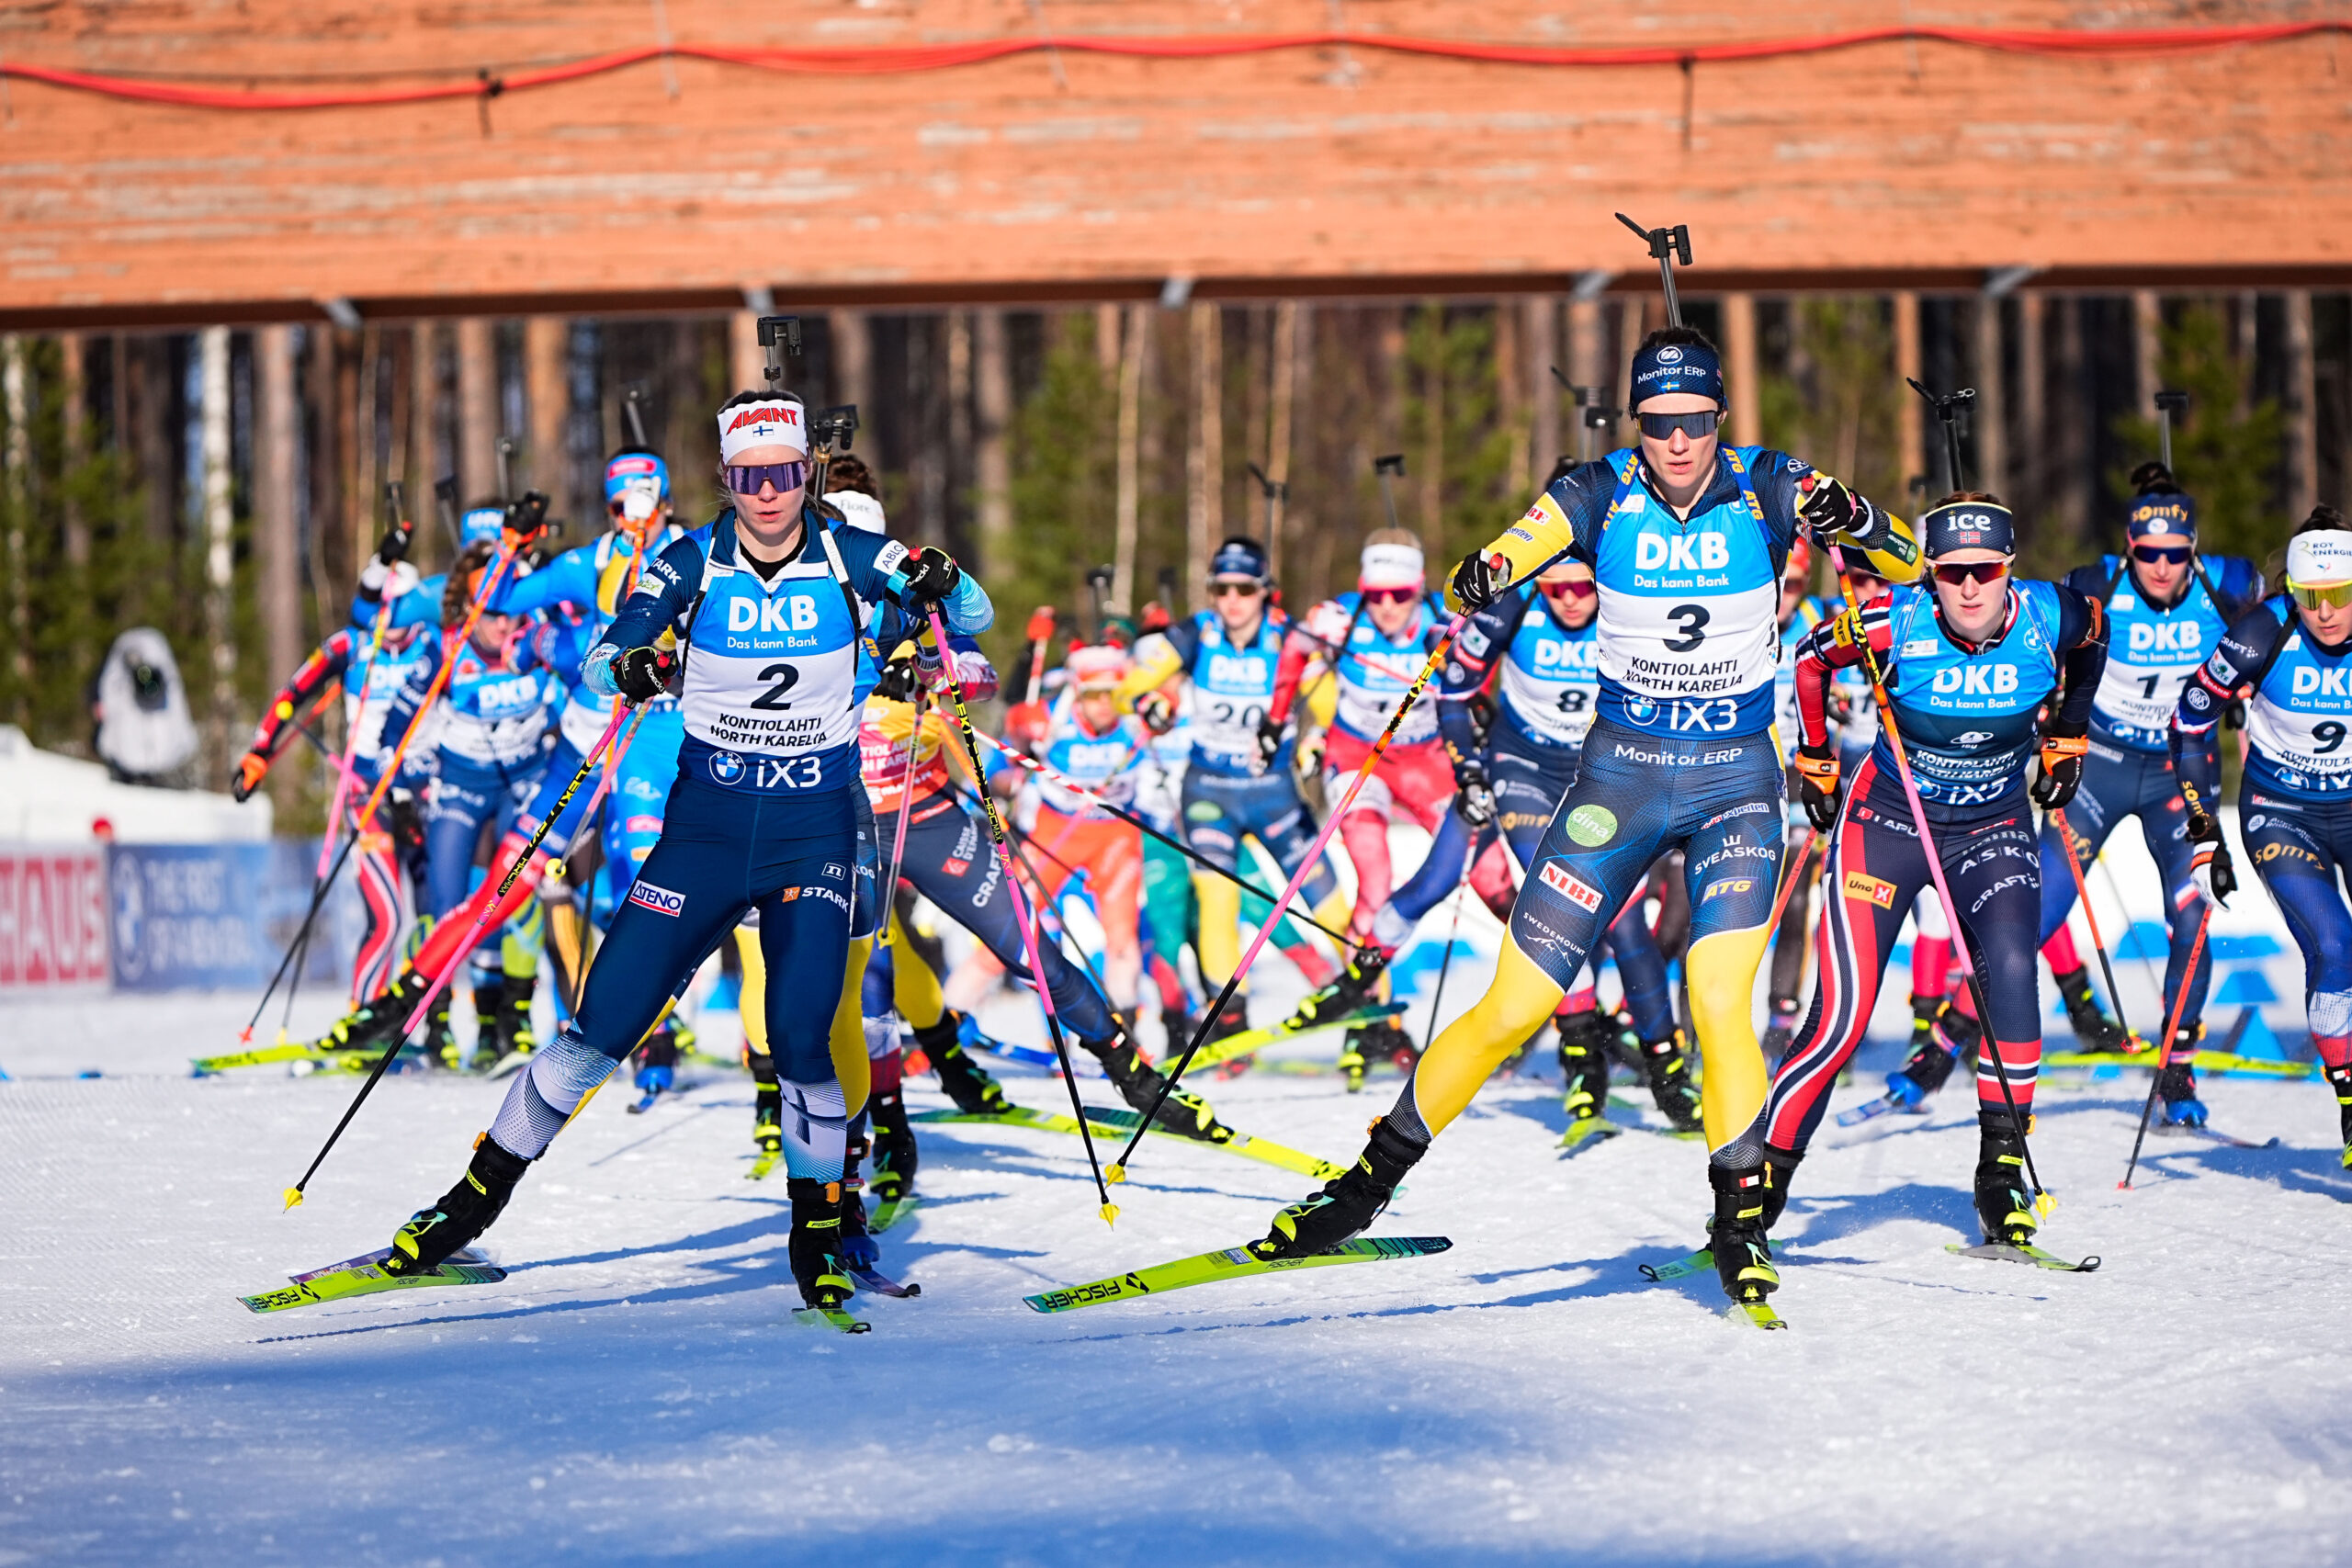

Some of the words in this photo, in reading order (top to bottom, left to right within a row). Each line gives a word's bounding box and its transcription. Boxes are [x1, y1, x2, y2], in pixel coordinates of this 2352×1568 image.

[1637, 367, 1682, 384] Monitor
[1684, 366, 1706, 378] ERP
[726, 407, 797, 435] AVANT
[1620, 454, 1639, 485] ATG
[1723, 447, 1745, 473] ATG
[1743, 490, 1764, 520] ATG
[2132, 503, 2188, 522] somfy
[1948, 510, 1991, 531] ice
[1635, 532, 1729, 570] DKB
[1634, 574, 1657, 588] Das
[1662, 576, 1692, 588] kann
[1696, 573, 1729, 587] Bank
[728, 595, 819, 632] DKB
[727, 637, 750, 649] Das
[753, 637, 784, 649] kann
[787, 635, 818, 648] Bank
[1663, 604, 1711, 653] 3
[2129, 620, 2202, 651] DKB
[645, 663, 665, 693] Roeckl
[1632, 656, 1738, 676] KONTIOLAHTI
[1932, 663, 2018, 694] DKB
[750, 663, 798, 711] 2
[1623, 669, 1673, 691] NORTH
[1677, 673, 1743, 693] KARELIA
[2292, 665, 2352, 696] DK
[951, 690, 972, 735] LEKI
[1556, 689, 1589, 713] 8
[1930, 695, 1952, 708] Das
[1956, 698, 1984, 708] kann
[1988, 696, 2017, 708] Bank
[2291, 696, 2312, 707] Das
[2314, 698, 2340, 709] kann
[718, 713, 821, 732] KONTIOLAHTI
[1214, 703, 1264, 728] 20
[1669, 698, 1738, 732] iX3
[710, 725, 761, 745] NORTH
[764, 731, 828, 747] KARELIA
[2312, 720, 2347, 754] 9
[1614, 744, 1700, 765] Monitor
[1703, 747, 1743, 764] ERP
[756, 756, 822, 788] iX3
[558, 769, 589, 807] LEKI
[1572, 811, 1609, 840] dina
[1695, 847, 1776, 874] SVEASKOG
[632, 883, 682, 910] ATENO
[802, 886, 849, 913] STARK
[1544, 866, 1600, 909] NIBE
[1704, 880, 1752, 901] ATG
[1849, 879, 1872, 893] Uno
[1972, 874, 2030, 913] CRAFT
[1523, 912, 1586, 956] SWEDEMOUNT
[250, 1289, 301, 1309] FISCHER
[1041, 1280, 1122, 1309] FISCHER
